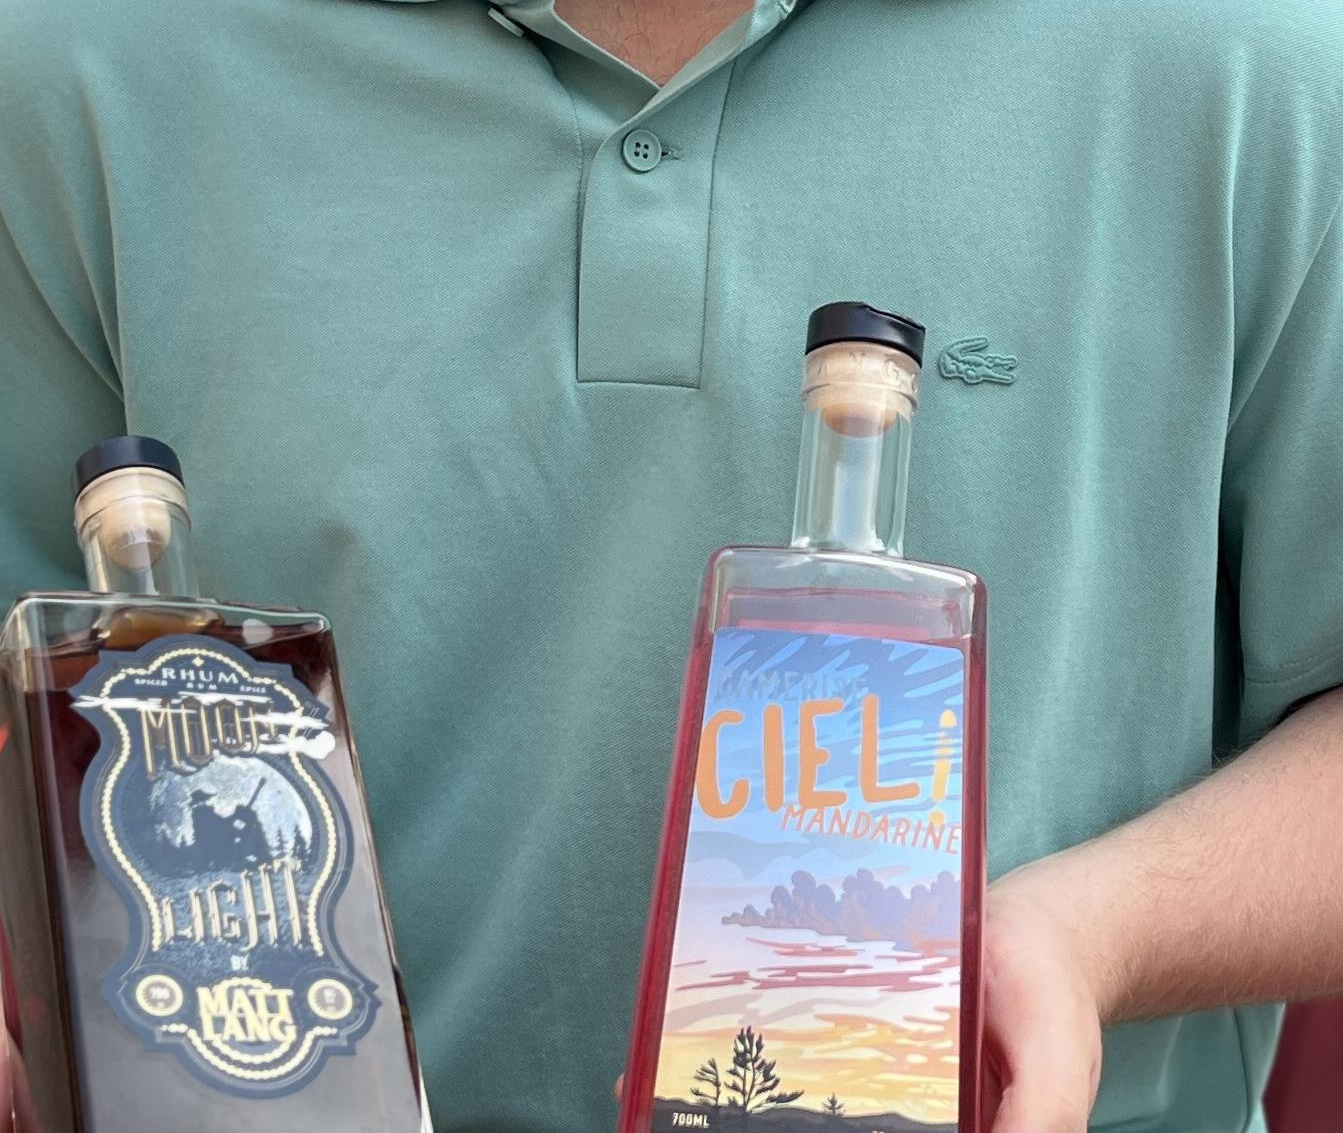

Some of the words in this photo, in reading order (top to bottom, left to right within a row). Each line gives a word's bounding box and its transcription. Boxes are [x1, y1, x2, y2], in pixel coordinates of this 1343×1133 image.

[162, 668, 239, 684] RHUM
[781, 802, 962, 855] MANDARINE
[161, 856, 304, 951] LIGHT
[230, 954, 249, 971] BY
[196, 986, 294, 1017] MATT
[200, 1012, 297, 1042] LANG
[672, 1112, 710, 1128] 700ML
